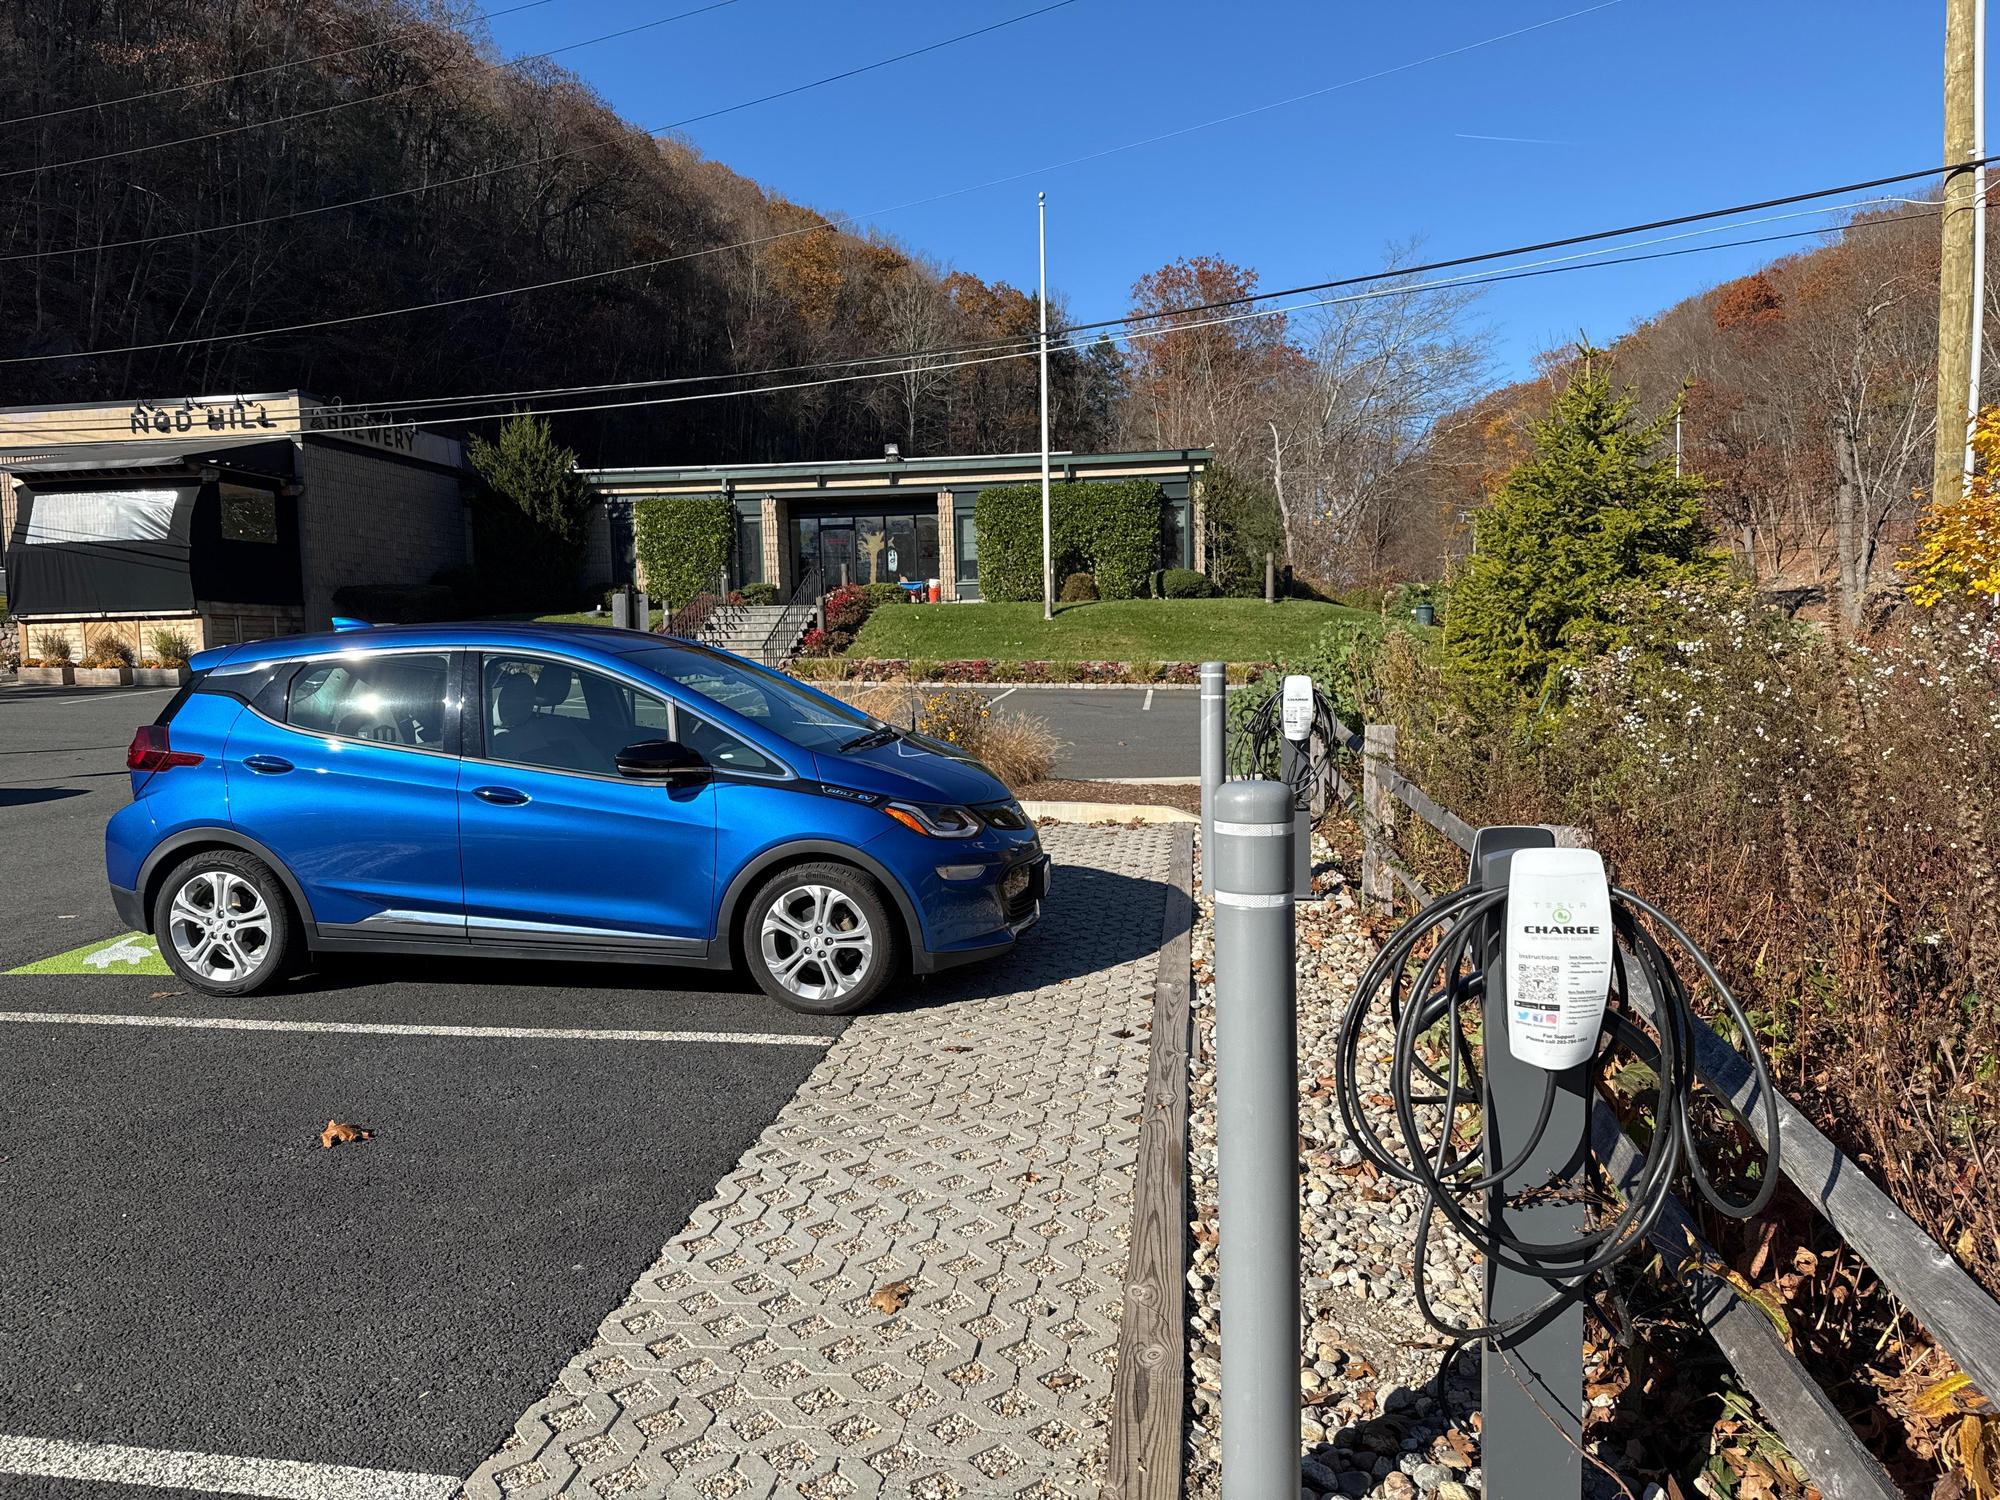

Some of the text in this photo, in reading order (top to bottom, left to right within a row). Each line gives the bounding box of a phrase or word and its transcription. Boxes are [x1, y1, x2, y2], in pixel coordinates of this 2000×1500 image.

[131, 407, 277, 434] NOD HILL
[328, 410, 415, 451] BREWERY
[1524, 925, 1600, 935] CHARGE
